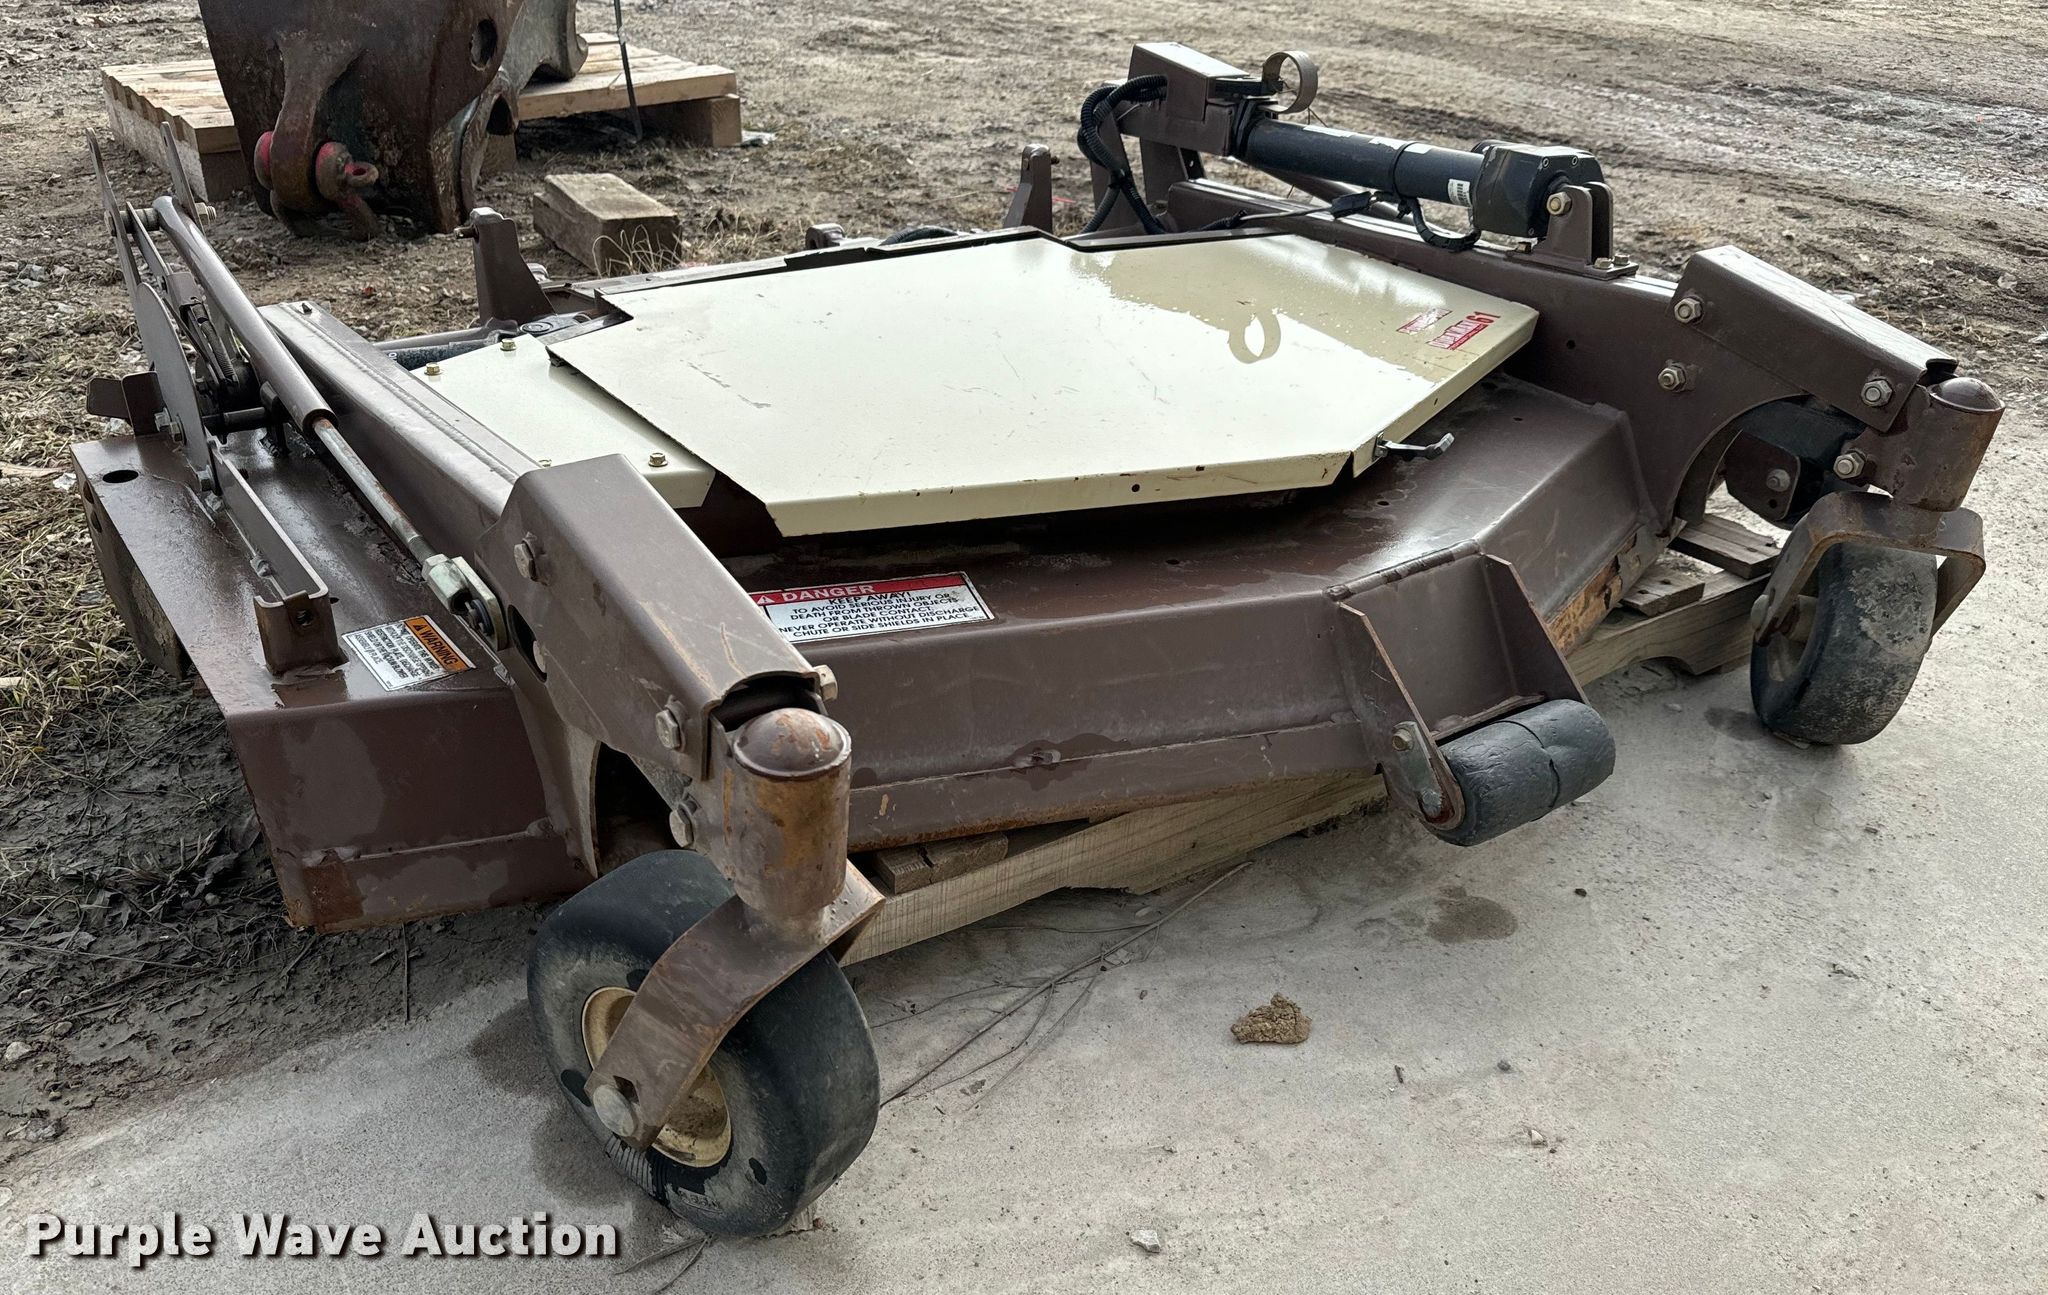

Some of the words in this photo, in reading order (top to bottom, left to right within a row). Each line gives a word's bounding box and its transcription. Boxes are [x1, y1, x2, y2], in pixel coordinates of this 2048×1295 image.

[781, 584, 875, 602] DANGER
[829, 595, 862, 605] KEEP
[867, 592, 911, 601] AWAY!
[791, 612, 826, 620] DEATH
[829, 608, 863, 616] FROM
[864, 601, 911, 612] THROWN
[913, 598, 959, 606] OBJECTS
[811, 604, 846, 612] AVOID
[849, 599, 895, 609] SERIOUS
[895, 595, 932, 604] INJURY
[778, 624, 815, 633] NEVER
[818, 619, 867, 628] OPERATE
[870, 613, 916, 623] WITHOUT
[919, 605, 981, 617] DISCHARGE
[841, 612, 877, 620] BLADE
[793, 629, 829, 637] CHUTE
[877, 619, 920, 628] SHIELDS
[420, 629, 459, 665] WARNING
